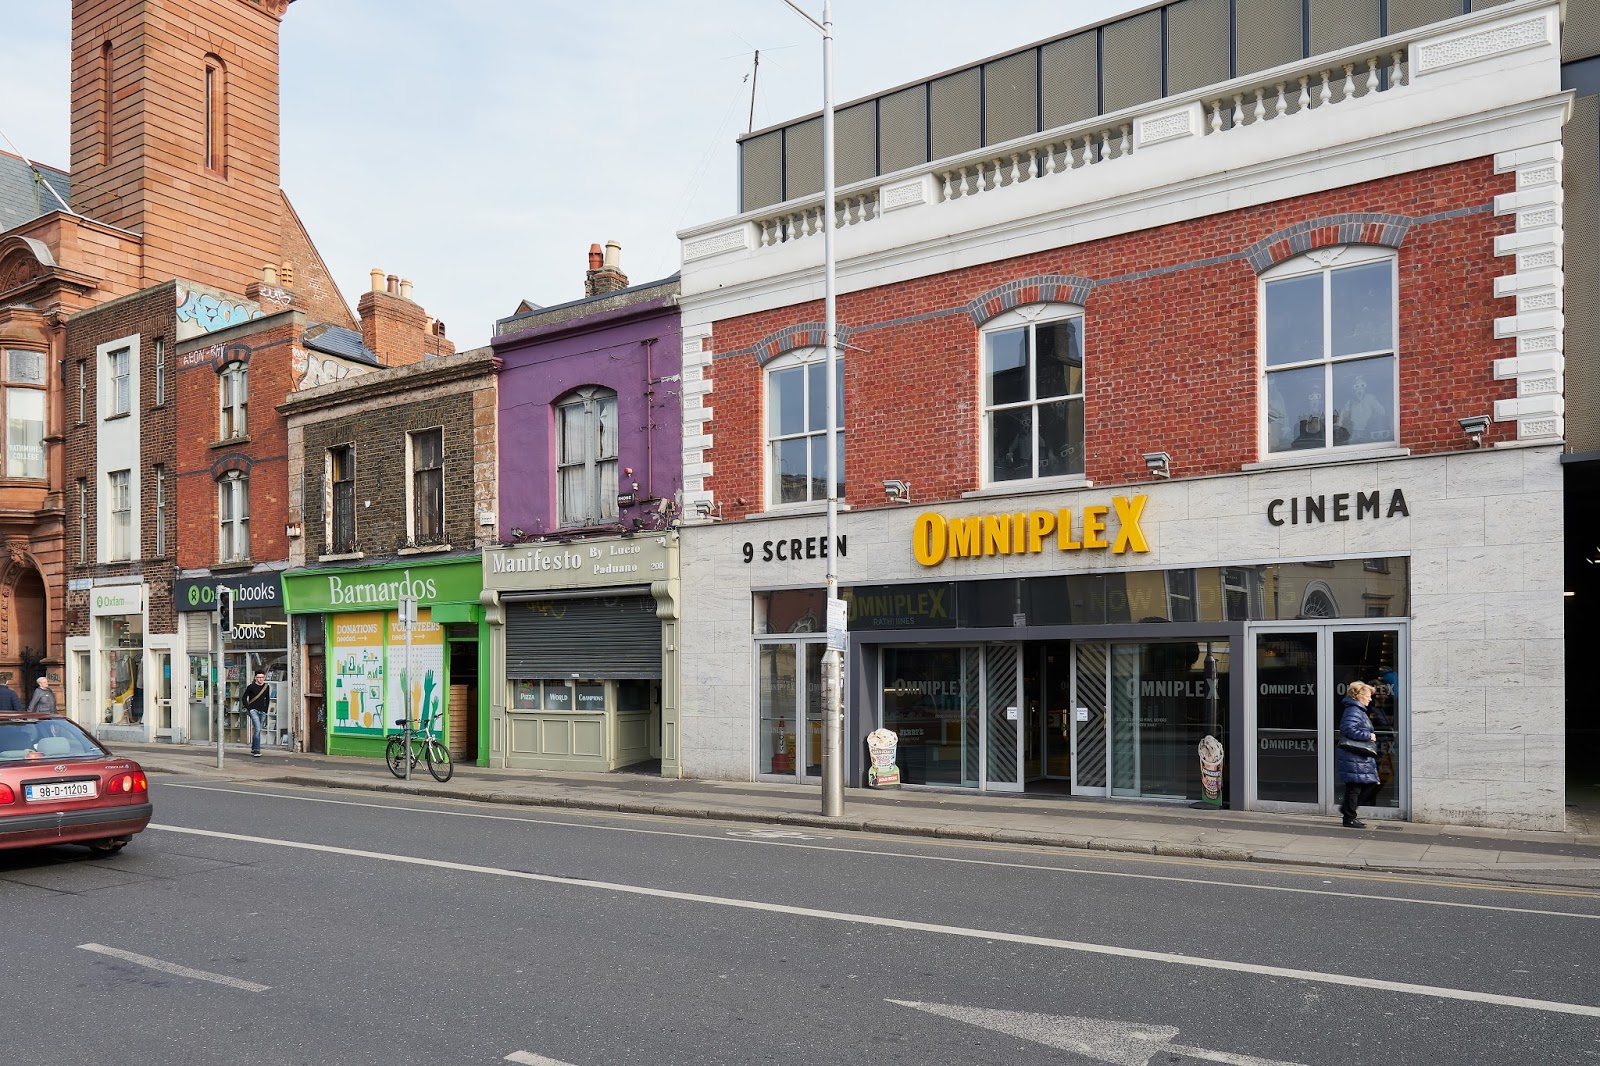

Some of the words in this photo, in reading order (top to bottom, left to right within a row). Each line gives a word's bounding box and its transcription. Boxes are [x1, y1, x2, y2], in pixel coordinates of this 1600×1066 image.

[1267, 488, 1410, 527] CINEMA
[913, 494, 1150, 567] OMNIPLEX
[589, 547, 603, 560] By
[610, 543, 642, 556] Lucio
[742, 541, 754, 564] 9
[762, 534, 847, 562] SCREEN
[492, 549, 583, 574] Manifesto
[593, 563, 638, 575] Paduano
[650, 562, 664, 571] 208
[240, 582, 275, 601] books
[328, 569, 437, 605] Barnardos
[104, 596, 125, 607] Oxfam
[336, 623, 378, 635] DONATIONS
[391, 621, 441, 633] VOLNTEERS
[1125, 678, 1220, 700] OMNIPLEX
[1260, 683, 1315, 696] OMNIPLEX
[1260, 738, 1315, 752] OMNIPLEX
[39, 784, 88, 798] 98-D-11209
